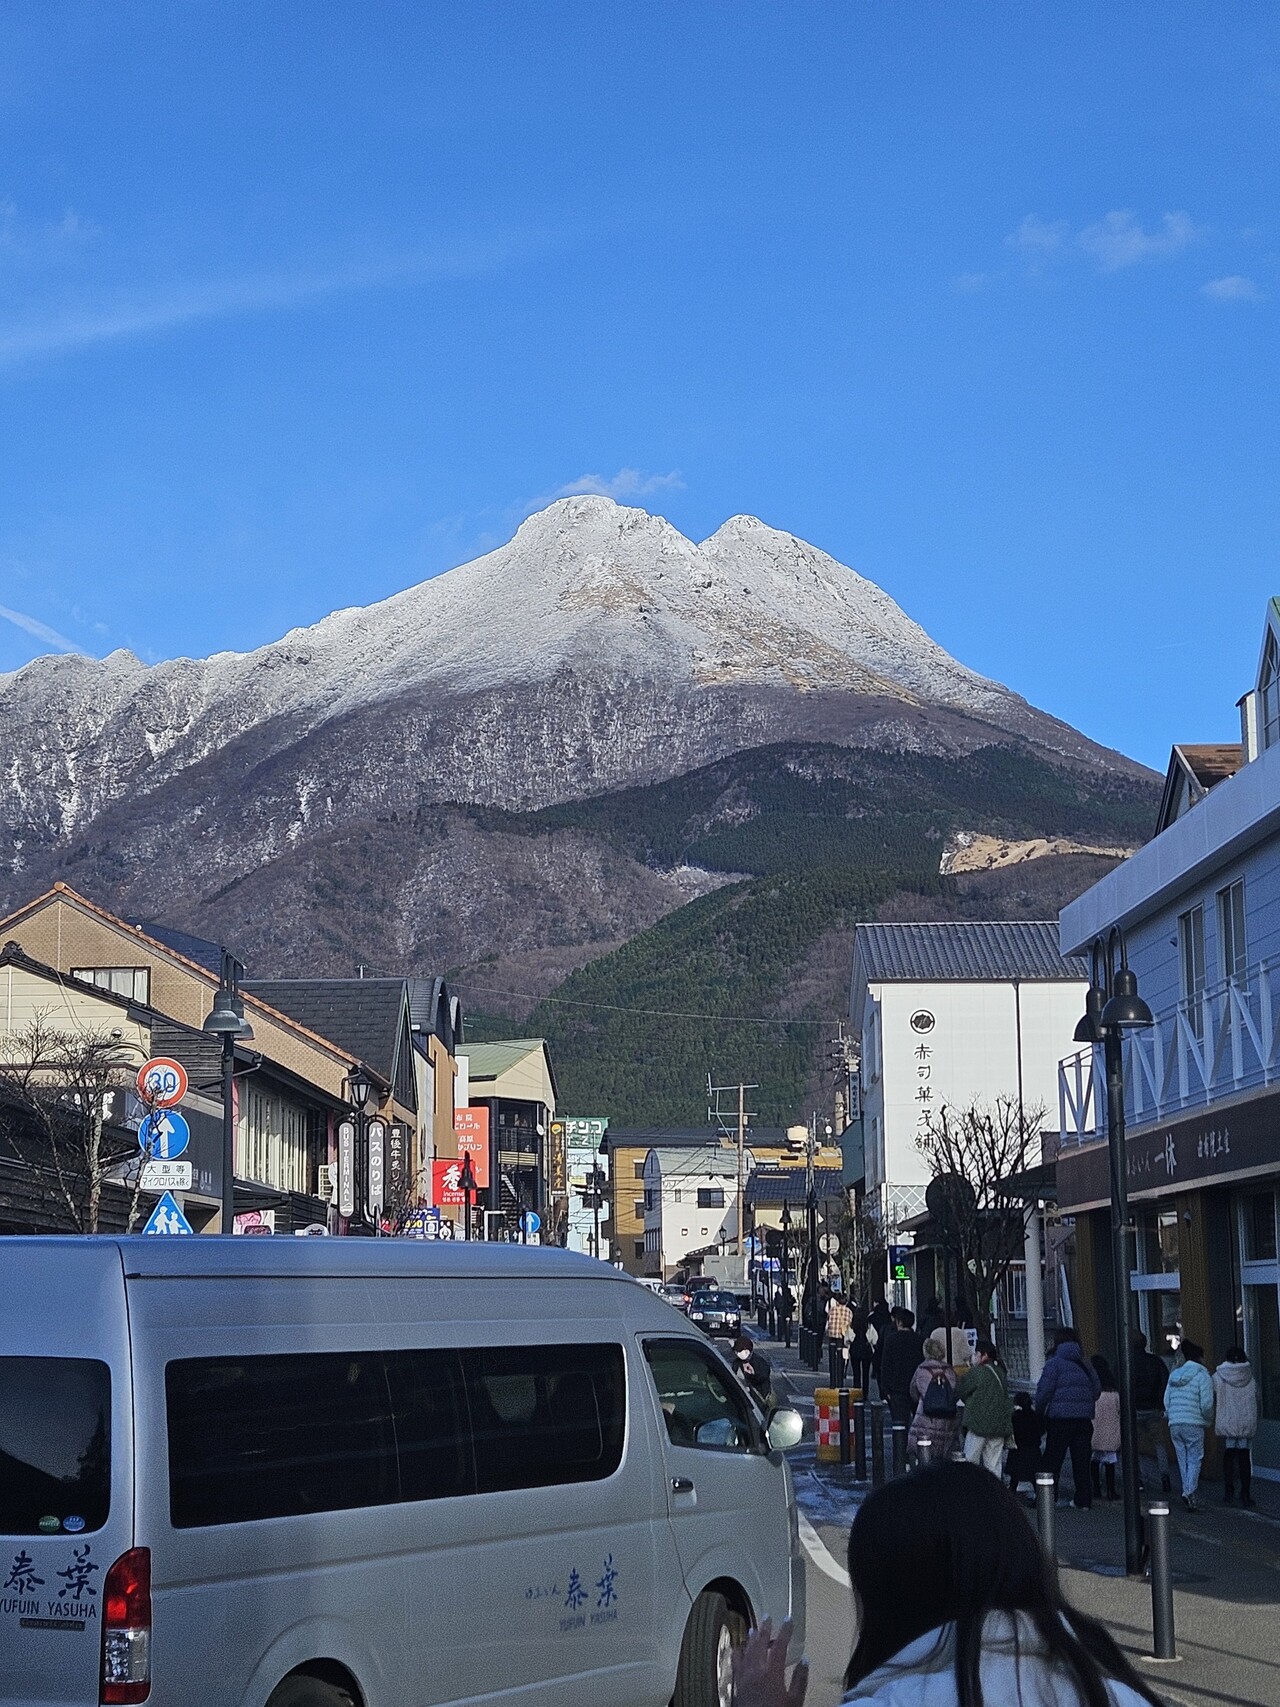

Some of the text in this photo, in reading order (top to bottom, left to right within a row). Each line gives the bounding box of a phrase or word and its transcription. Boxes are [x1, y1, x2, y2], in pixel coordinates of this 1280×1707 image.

[150, 1072, 176, 1093] 30
[914, 1043, 934, 1149] 赤司菓子舗
[146, 1164, 186, 1175] 大型等
[370, 1127, 383, 1196] バスのりば
[1154, 1132, 1178, 1176] 一休
[142, 1176, 190, 1187] マイクロバスを除く
[3, 1544, 99, 1600] 泰葉
[564, 1553, 618, 1611] 泰葉
[47, 1601, 97, 1618] YASUHA
